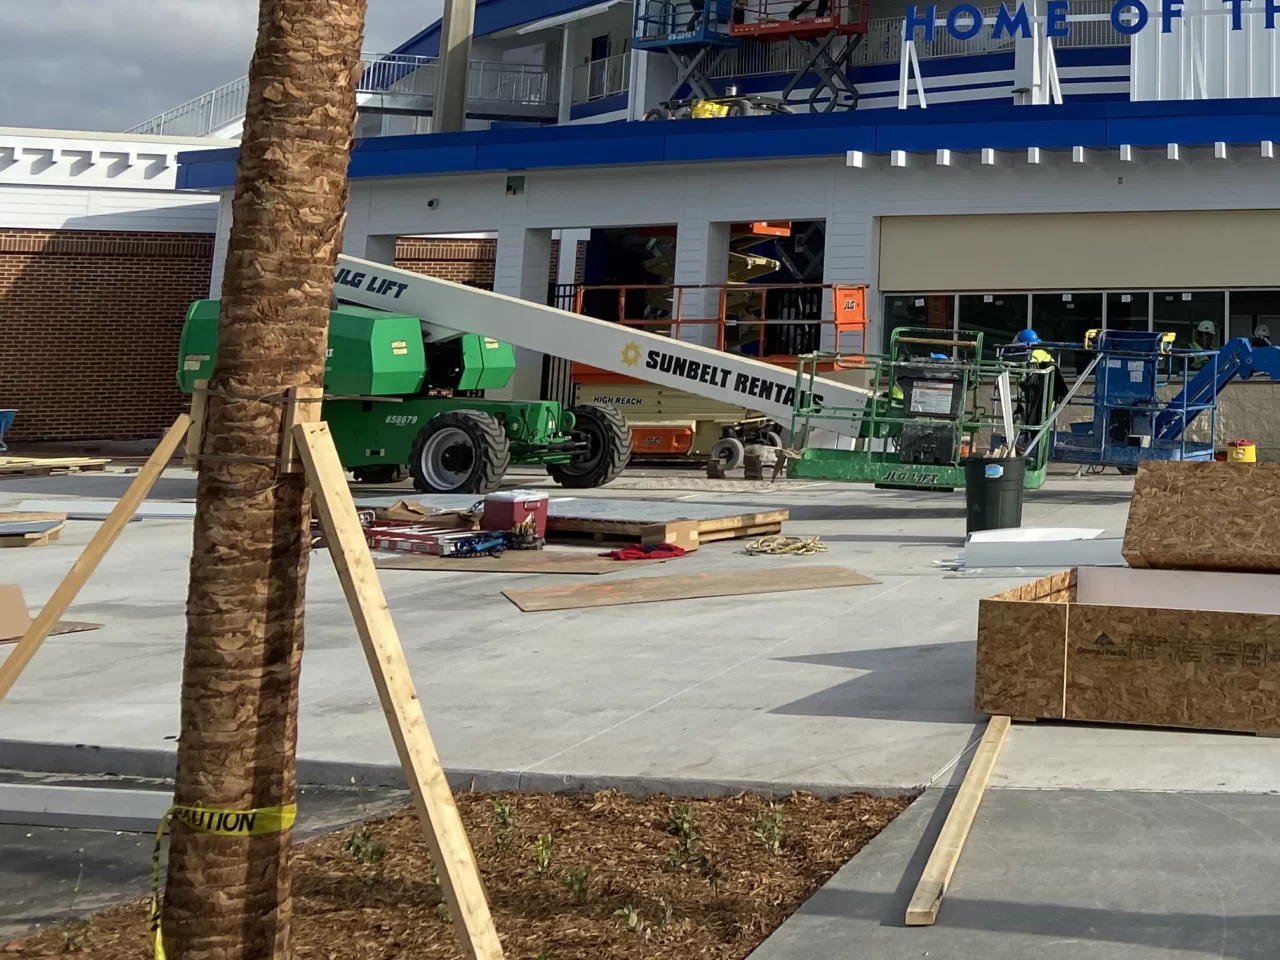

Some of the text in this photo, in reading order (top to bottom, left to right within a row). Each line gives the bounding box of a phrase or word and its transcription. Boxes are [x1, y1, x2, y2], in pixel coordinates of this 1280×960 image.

[904, 0, 1071, 42] HOME
[334, 267, 409, 299] JLG LIFT
[843, 300, 856, 310] JLG
[645, 349, 734, 389] SUNBELT
[593, 395, 643, 406] HIGH REACH
[385, 415, 418, 425] 858679
